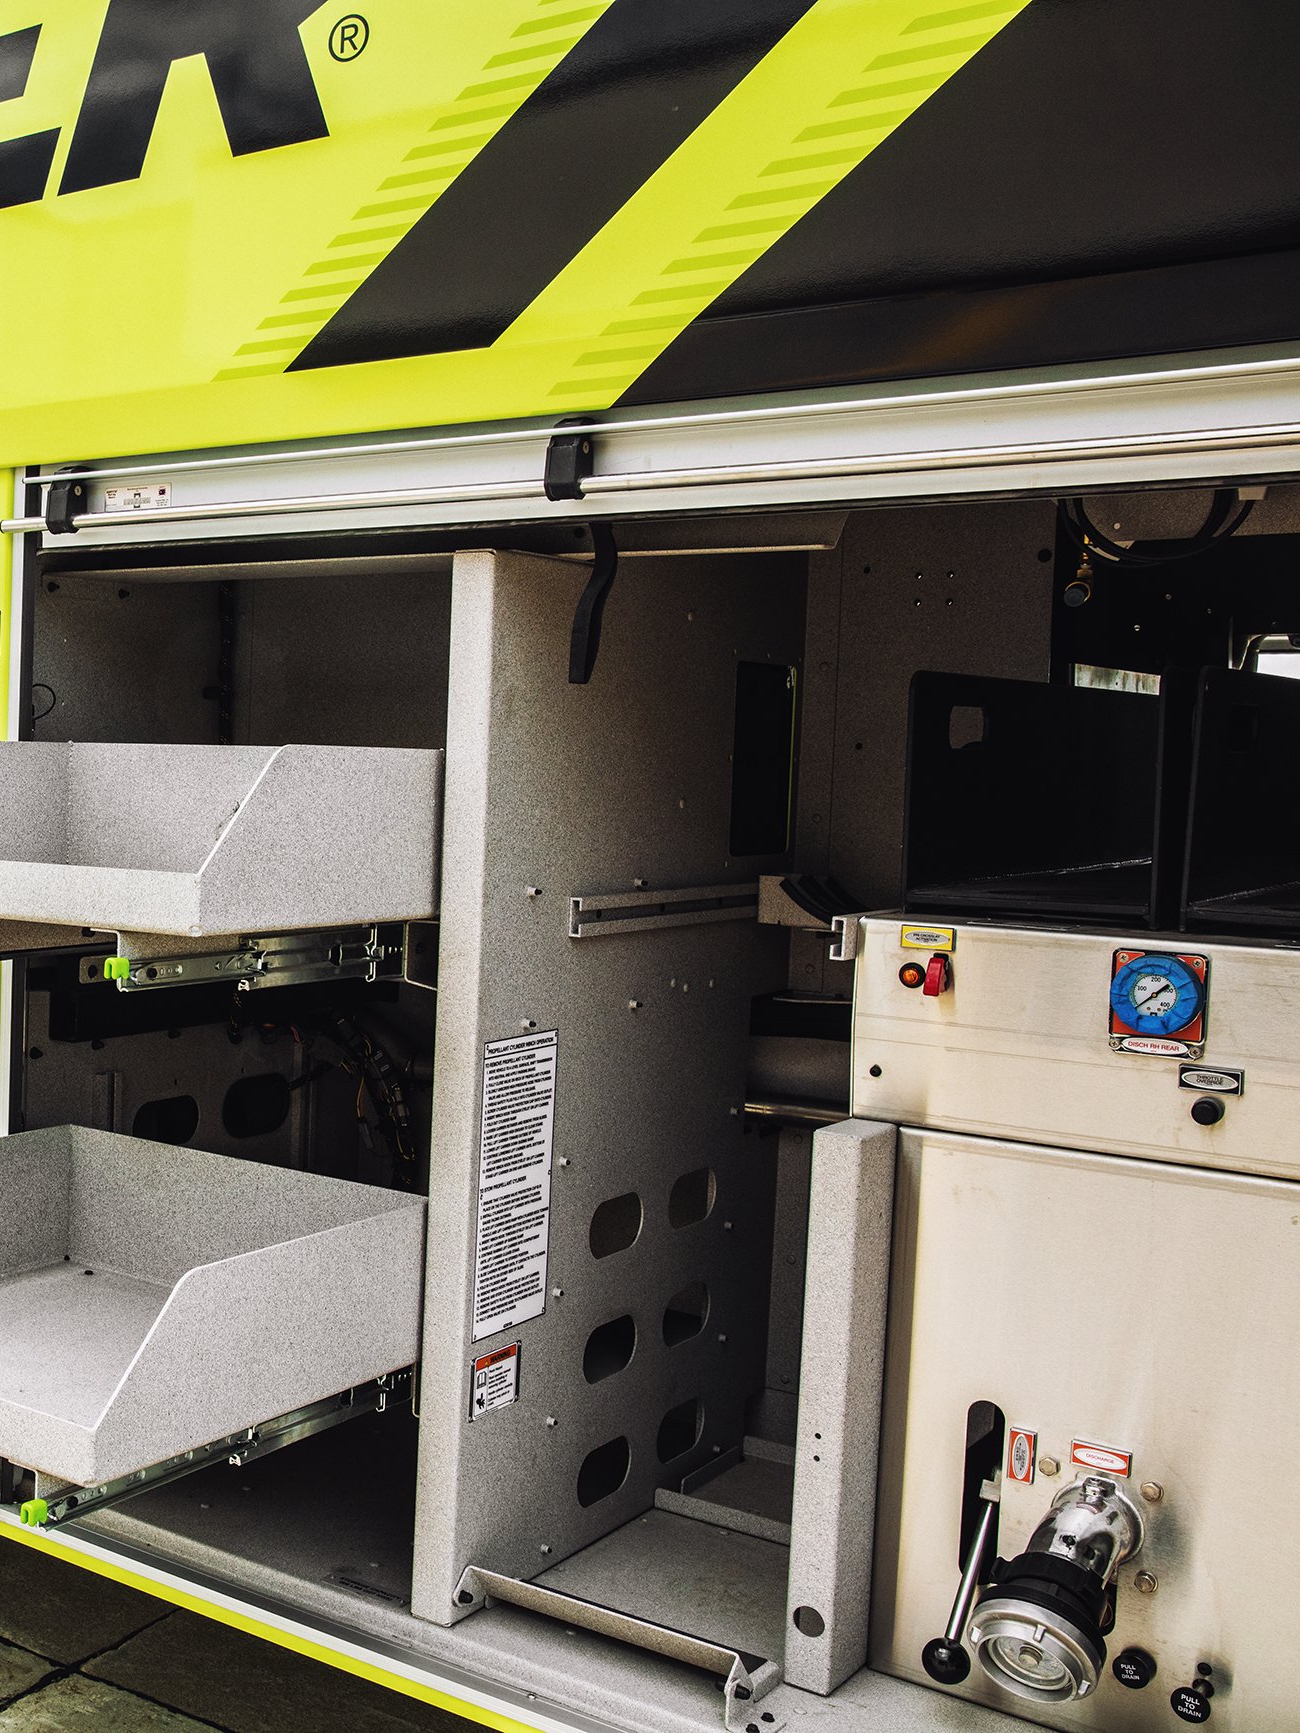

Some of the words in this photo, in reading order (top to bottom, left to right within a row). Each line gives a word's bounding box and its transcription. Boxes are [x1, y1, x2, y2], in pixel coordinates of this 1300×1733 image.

[1127, 1040, 1149, 1049] DISCH
[1160, 1044, 1180, 1052] REAR
[490, 1349, 511, 1364] WARNING
[1086, 1452, 1115, 1464] DISCHARGE
[1180, 1694, 1200, 1705] PULL
[1177, 1705, 1202, 1718] DRAIN
